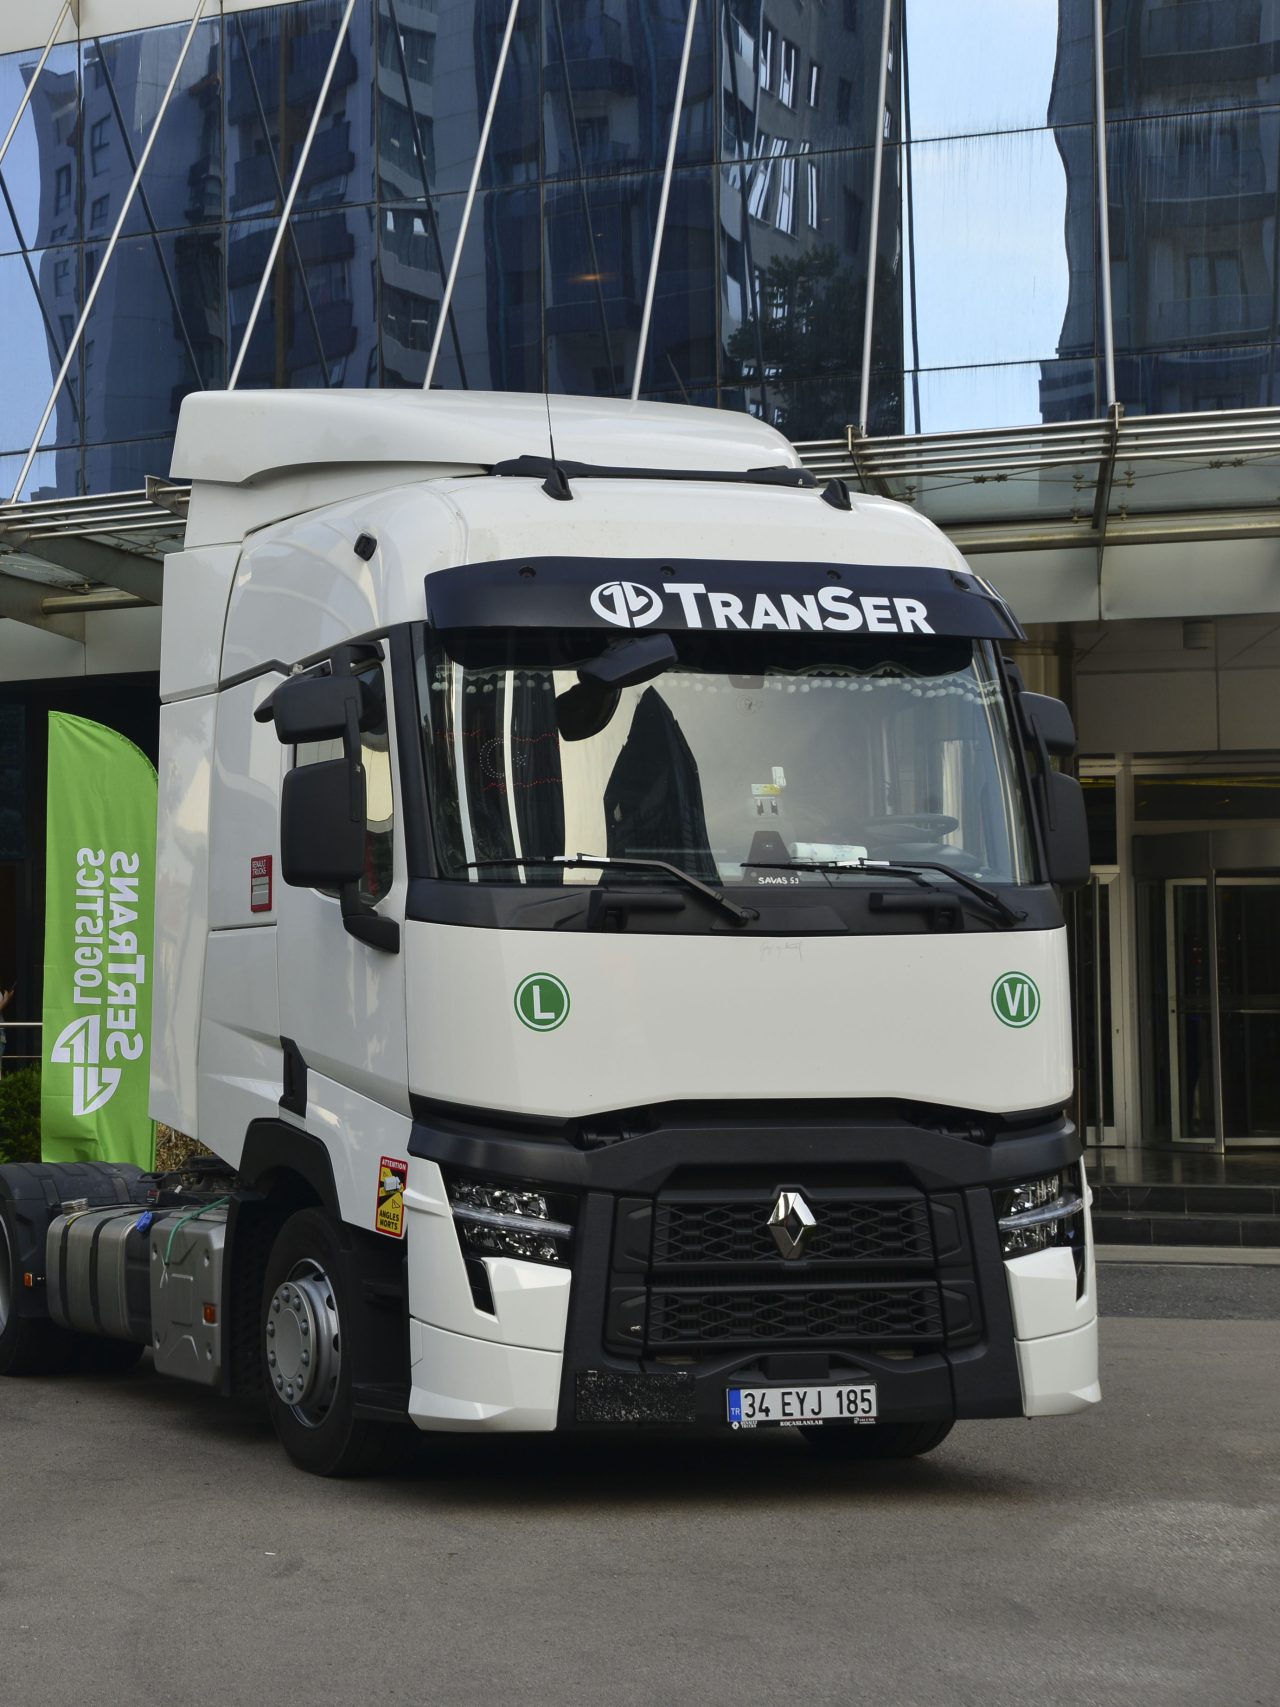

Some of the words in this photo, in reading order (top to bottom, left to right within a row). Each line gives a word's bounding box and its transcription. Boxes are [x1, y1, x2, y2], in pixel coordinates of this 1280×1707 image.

[532, 985, 555, 1020] L
[1003, 982, 1030, 1017] VI
[381, 1159, 406, 1170] ATTENTION
[380, 1209, 399, 1222] ANGLES
[380, 1219, 398, 1231] MORTS
[744, 1392, 770, 1418] 34
[782, 1390, 822, 1417] EYJ
[836, 1389, 872, 1415] 185
[730, 1407, 741, 1416] TR
